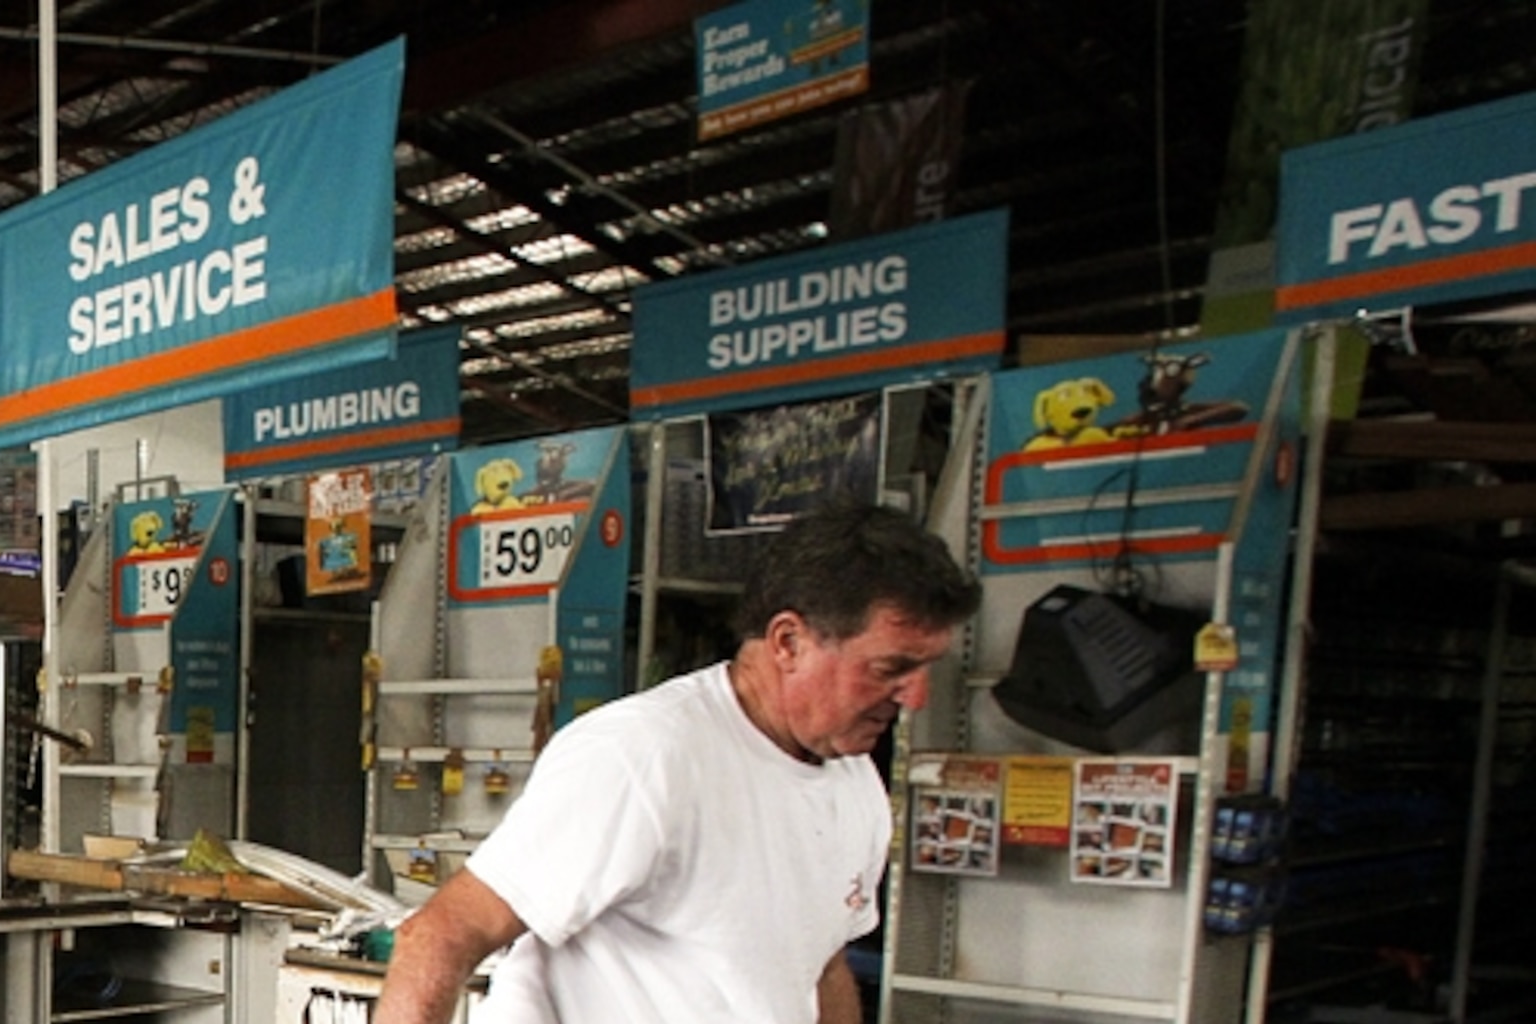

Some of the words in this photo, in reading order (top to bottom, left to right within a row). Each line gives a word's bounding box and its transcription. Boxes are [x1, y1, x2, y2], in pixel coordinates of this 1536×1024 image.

[69, 177, 211, 281] SALES
[229, 156, 266, 224] &
[1327, 171, 1536, 265] FAST
[68, 236, 268, 355] SERVICE
[709, 255, 907, 327] BUILDING
[707, 302, 907, 369] SUPPLIES
[253, 382, 420, 442] PLUMBING
